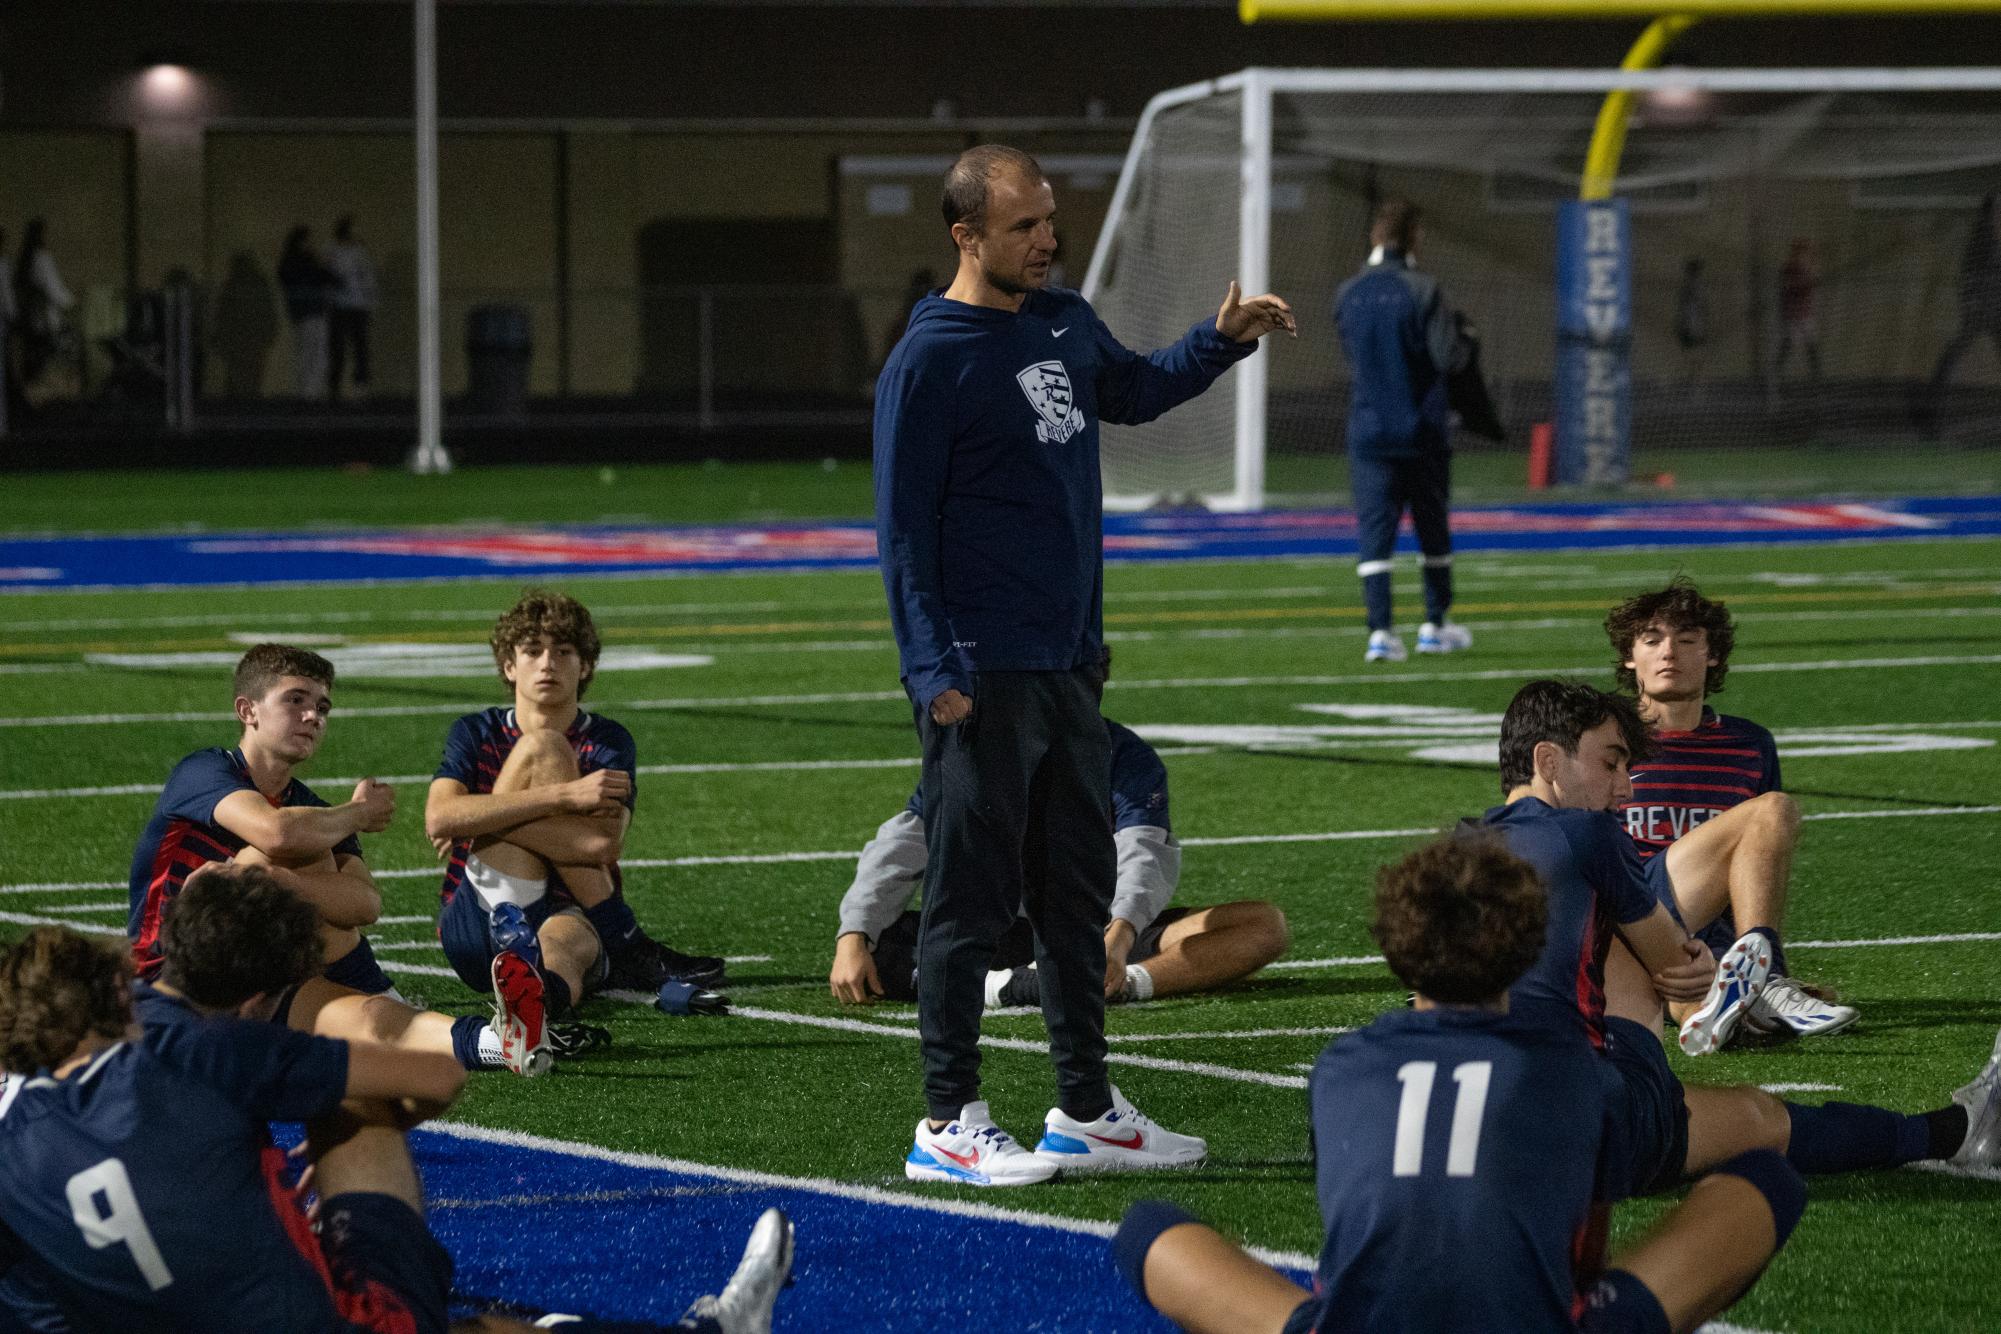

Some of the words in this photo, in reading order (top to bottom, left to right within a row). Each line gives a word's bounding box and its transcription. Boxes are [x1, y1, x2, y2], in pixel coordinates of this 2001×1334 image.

[1046, 416, 1075, 442] REVERE
[1627, 806, 1723, 840] REVE
[1393, 1061, 1493, 1177] 11
[65, 1157, 174, 1291] 9
